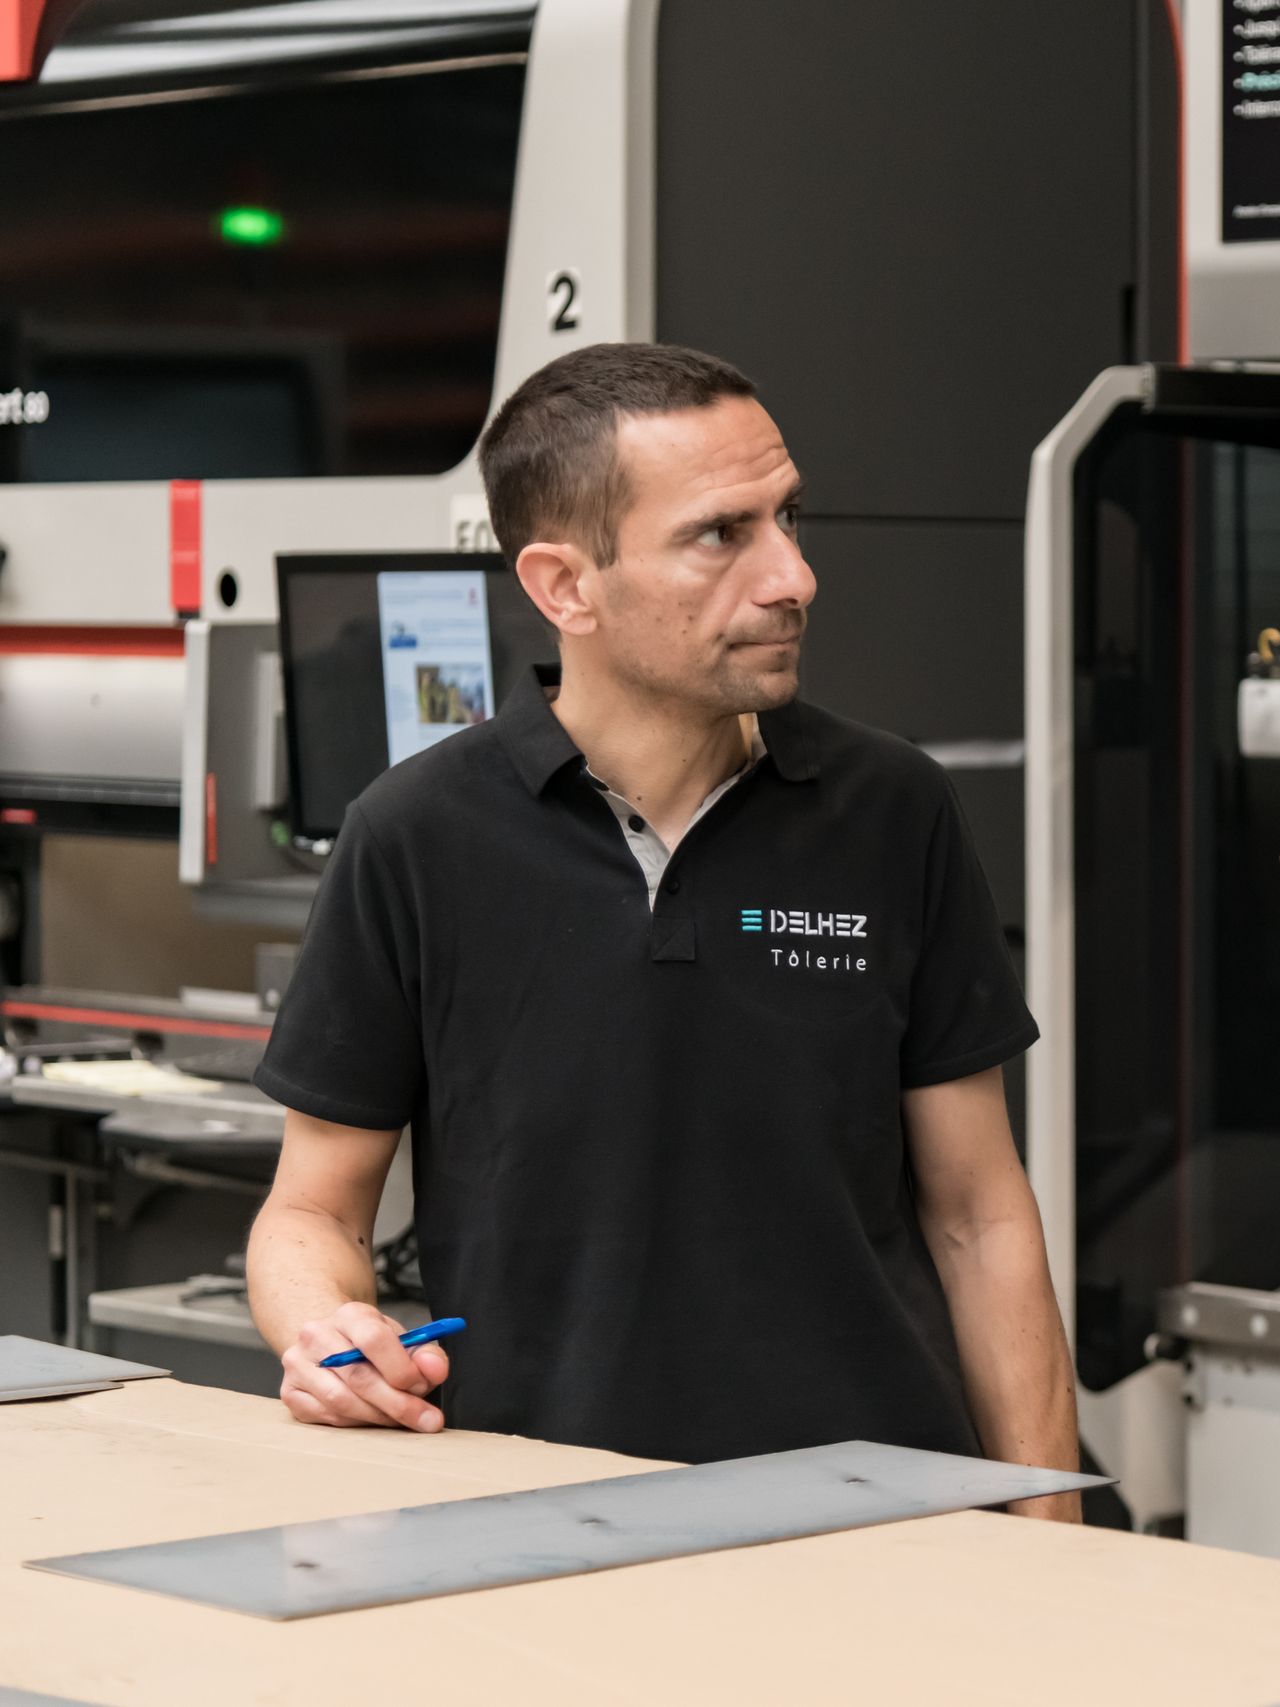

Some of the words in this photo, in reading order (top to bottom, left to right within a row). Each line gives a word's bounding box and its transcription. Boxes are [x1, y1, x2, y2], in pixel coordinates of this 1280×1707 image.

[550, 272, 580, 333] 2
[770, 909, 868, 938] DELHEZ
[770, 949, 867, 971] Tôlerie
